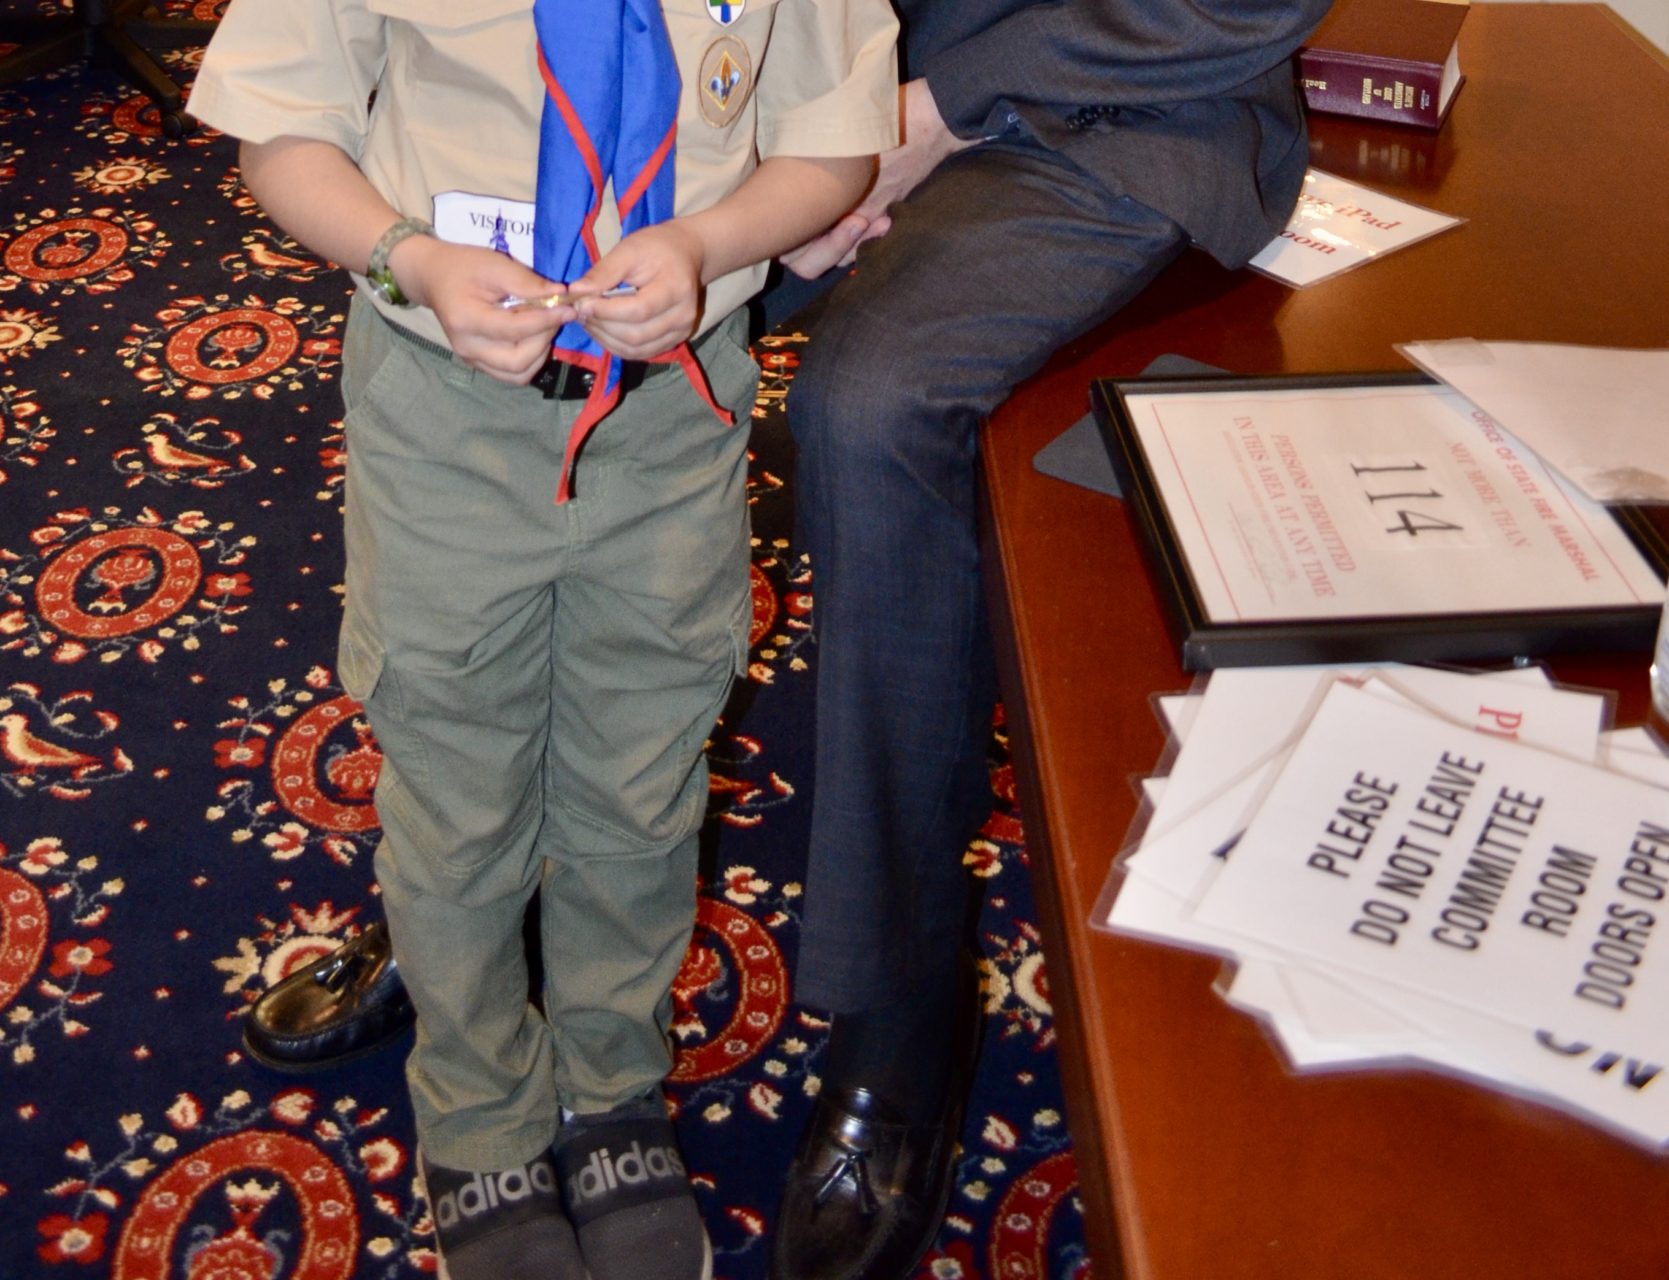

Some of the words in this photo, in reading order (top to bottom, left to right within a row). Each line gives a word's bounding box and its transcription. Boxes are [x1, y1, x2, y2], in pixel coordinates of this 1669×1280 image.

[469, 212, 534, 235] VISTOR
[1280, 230, 1337, 255] oom
[1233, 416, 1255, 430] IN
[1471, 410, 1504, 444] OFFICE
[1241, 432, 1270, 461] THIS
[1496, 447, 1518, 462] OF
[1255, 465, 1288, 500] AREA
[1349, 460, 1464, 536] 114
[1445, 441, 1477, 466] NOT
[1465, 469, 1501, 505] MORE
[1491, 508, 1533, 548] THAN
[1506, 463, 1539, 494] STATE
[1270, 434, 1314, 490] PERSONS
[1301, 494, 1357, 572] PERMITTED
[1274, 504, 1300, 522] AT
[1530, 497, 1559, 520] FIRE
[1286, 527, 1318, 556] ANY
[1549, 524, 1600, 581] MARSHAL
[1301, 559, 1337, 597] TIME
[1407, 751, 1486, 838] LEAVE
[1306, 771, 1399, 879] PLEASE
[1375, 835, 1442, 900] NOT
[1430, 785, 1546, 952] COMMITTEE
[1519, 843, 1599, 939] ROOM
[1349, 899, 1411, 946] DO
[1573, 902, 1657, 1011] DOORS
[1616, 819, 1669, 902] OPEN
[437, 1161, 558, 1229] adida
